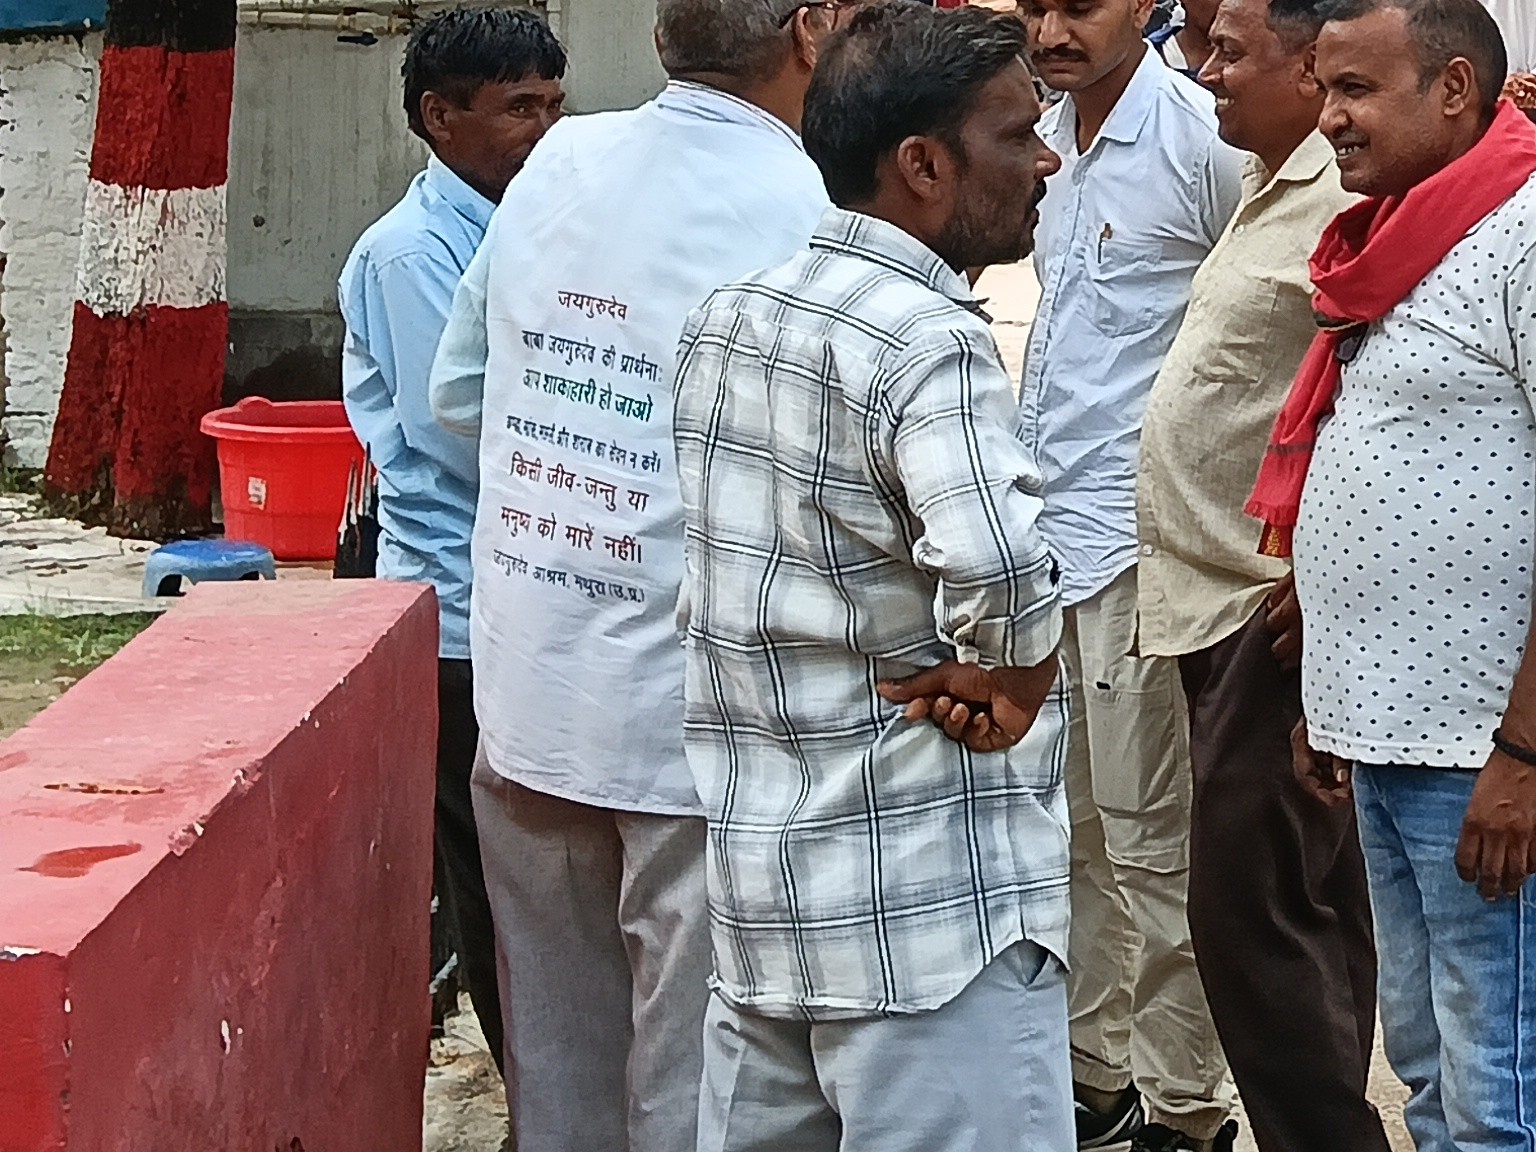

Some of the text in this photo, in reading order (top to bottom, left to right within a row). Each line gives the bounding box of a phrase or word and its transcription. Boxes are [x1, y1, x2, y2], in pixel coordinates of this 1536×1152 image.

[558, 291, 627, 320] जयगुरुदेव
[601, 345, 616, 369] की
[543, 374, 596, 405] शाकाहारी
[599, 383, 612, 410] हो
[615, 394, 653, 422] जाओ
[510, 451, 542, 482] किसी
[627, 489, 650, 512] या
[538, 513, 557, 540] को
[565, 523, 595, 550] मारें
